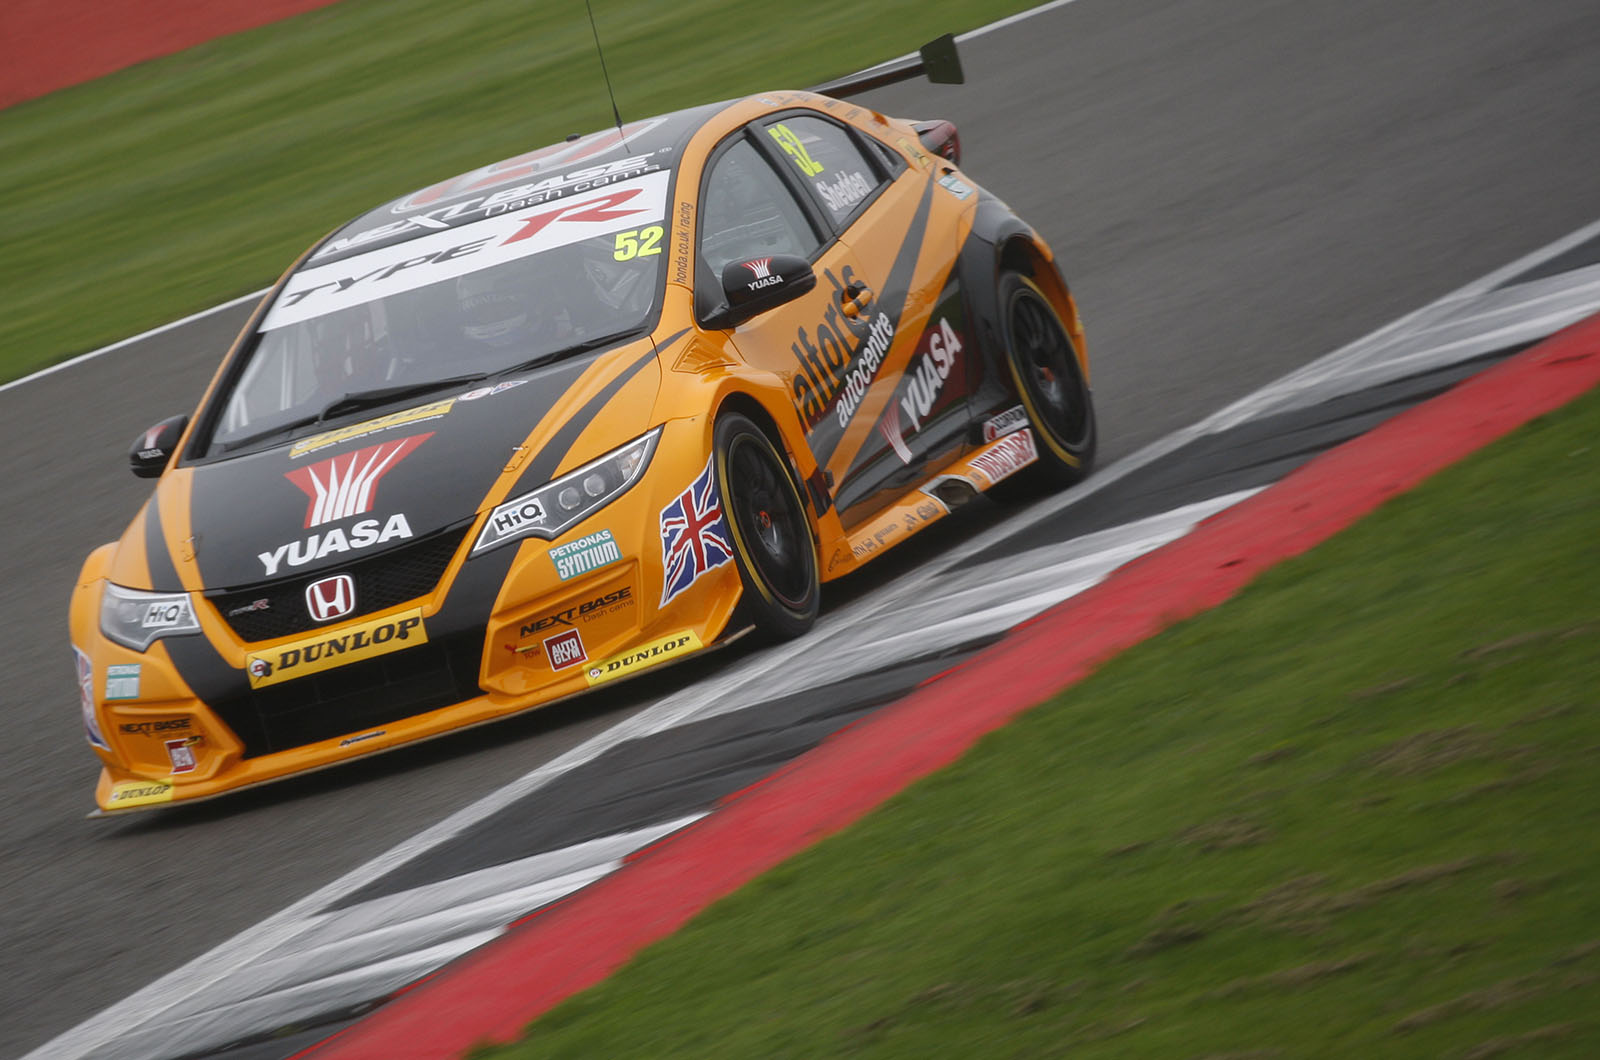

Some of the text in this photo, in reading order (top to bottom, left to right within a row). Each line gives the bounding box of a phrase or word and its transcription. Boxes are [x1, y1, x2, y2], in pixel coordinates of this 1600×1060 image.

[767, 123, 825, 177] 52
[484, 163, 661, 217] Dash cams
[815, 170, 873, 211] Shedden
[281, 188, 653, 309] TYPE R
[613, 225, 663, 262] 52
[747, 273, 784, 291] YUASA
[836, 312, 893, 428] autocentre
[901, 317, 962, 432] YUASA
[494, 503, 543, 532] HiQ
[257, 513, 413, 576] YUASA
[549, 530, 611, 559] PETRONAS
[556, 540, 619, 581] SYNTIUM
[147, 603, 181, 623] HiQ
[583, 599, 634, 624] Dash cams
[276, 615, 421, 672] DUNLOP
[551, 637, 577, 654] AUTO
[553, 647, 581, 665] GLYM
[606, 635, 692, 673] DUNLOP
[119, 784, 172, 801] DUNLOP
